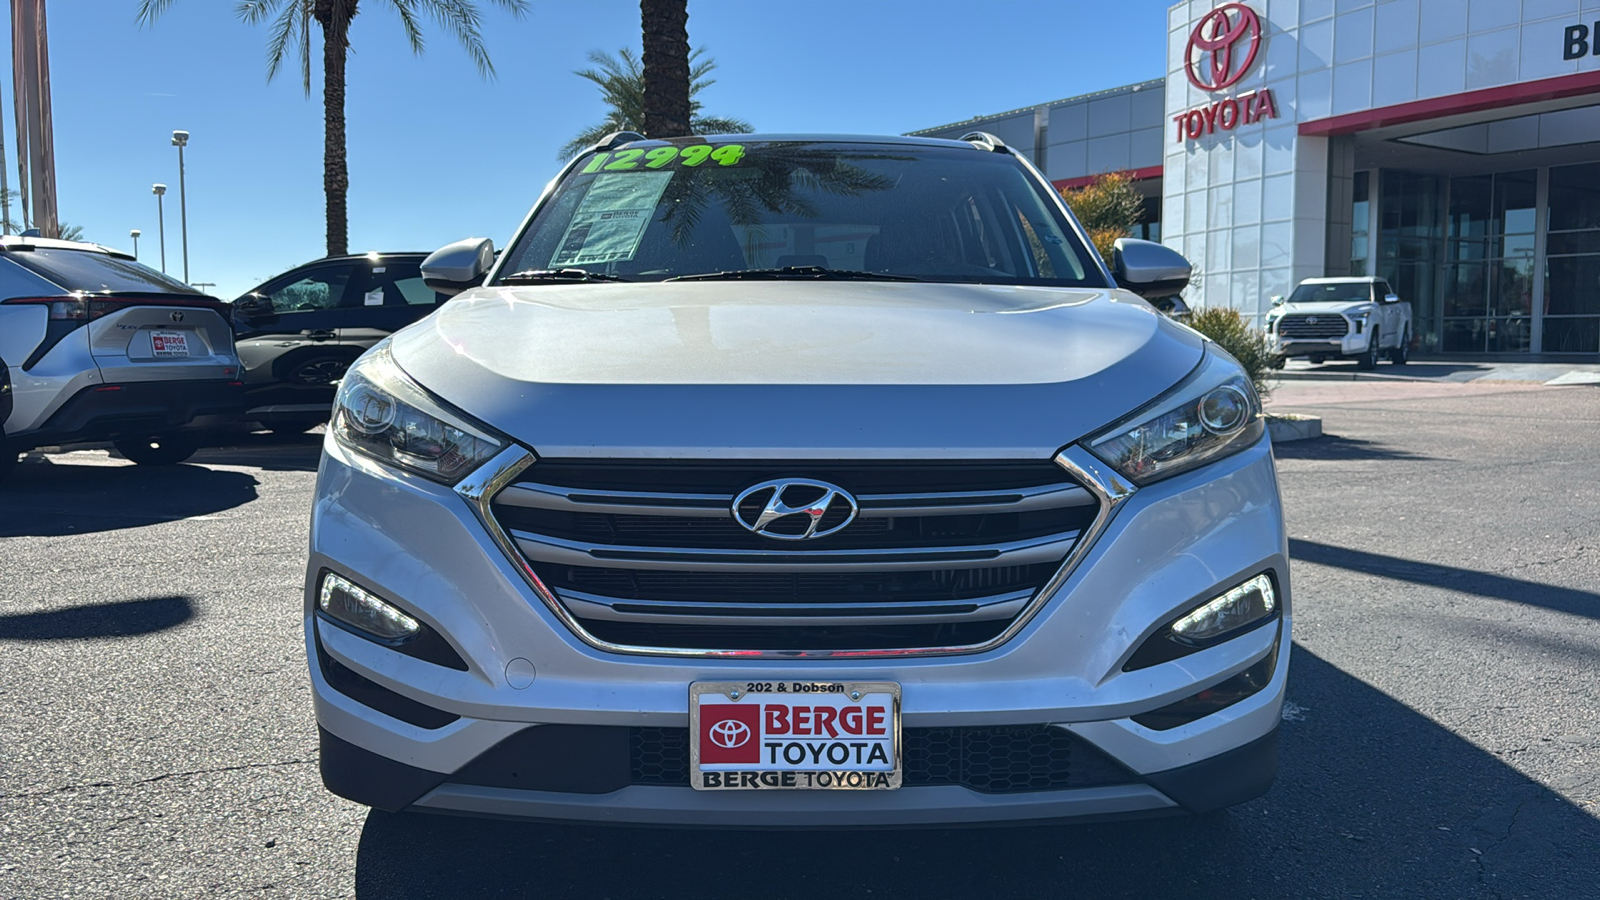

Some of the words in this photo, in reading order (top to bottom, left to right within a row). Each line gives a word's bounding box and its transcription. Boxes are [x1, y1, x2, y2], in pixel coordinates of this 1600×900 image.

[1173, 87, 1276, 143] TOYOTA
[582, 145, 746, 174] 12994
[164, 337, 186, 345] BERGE
[746, 682, 773, 693] 202
[777, 682, 788, 693] &
[792, 682, 845, 693] Dobson
[764, 704, 887, 739] BERGE
[764, 742, 889, 765] TOYOTA
[702, 771, 797, 789] BERGE
[802, 771, 891, 788] TOYOTA
